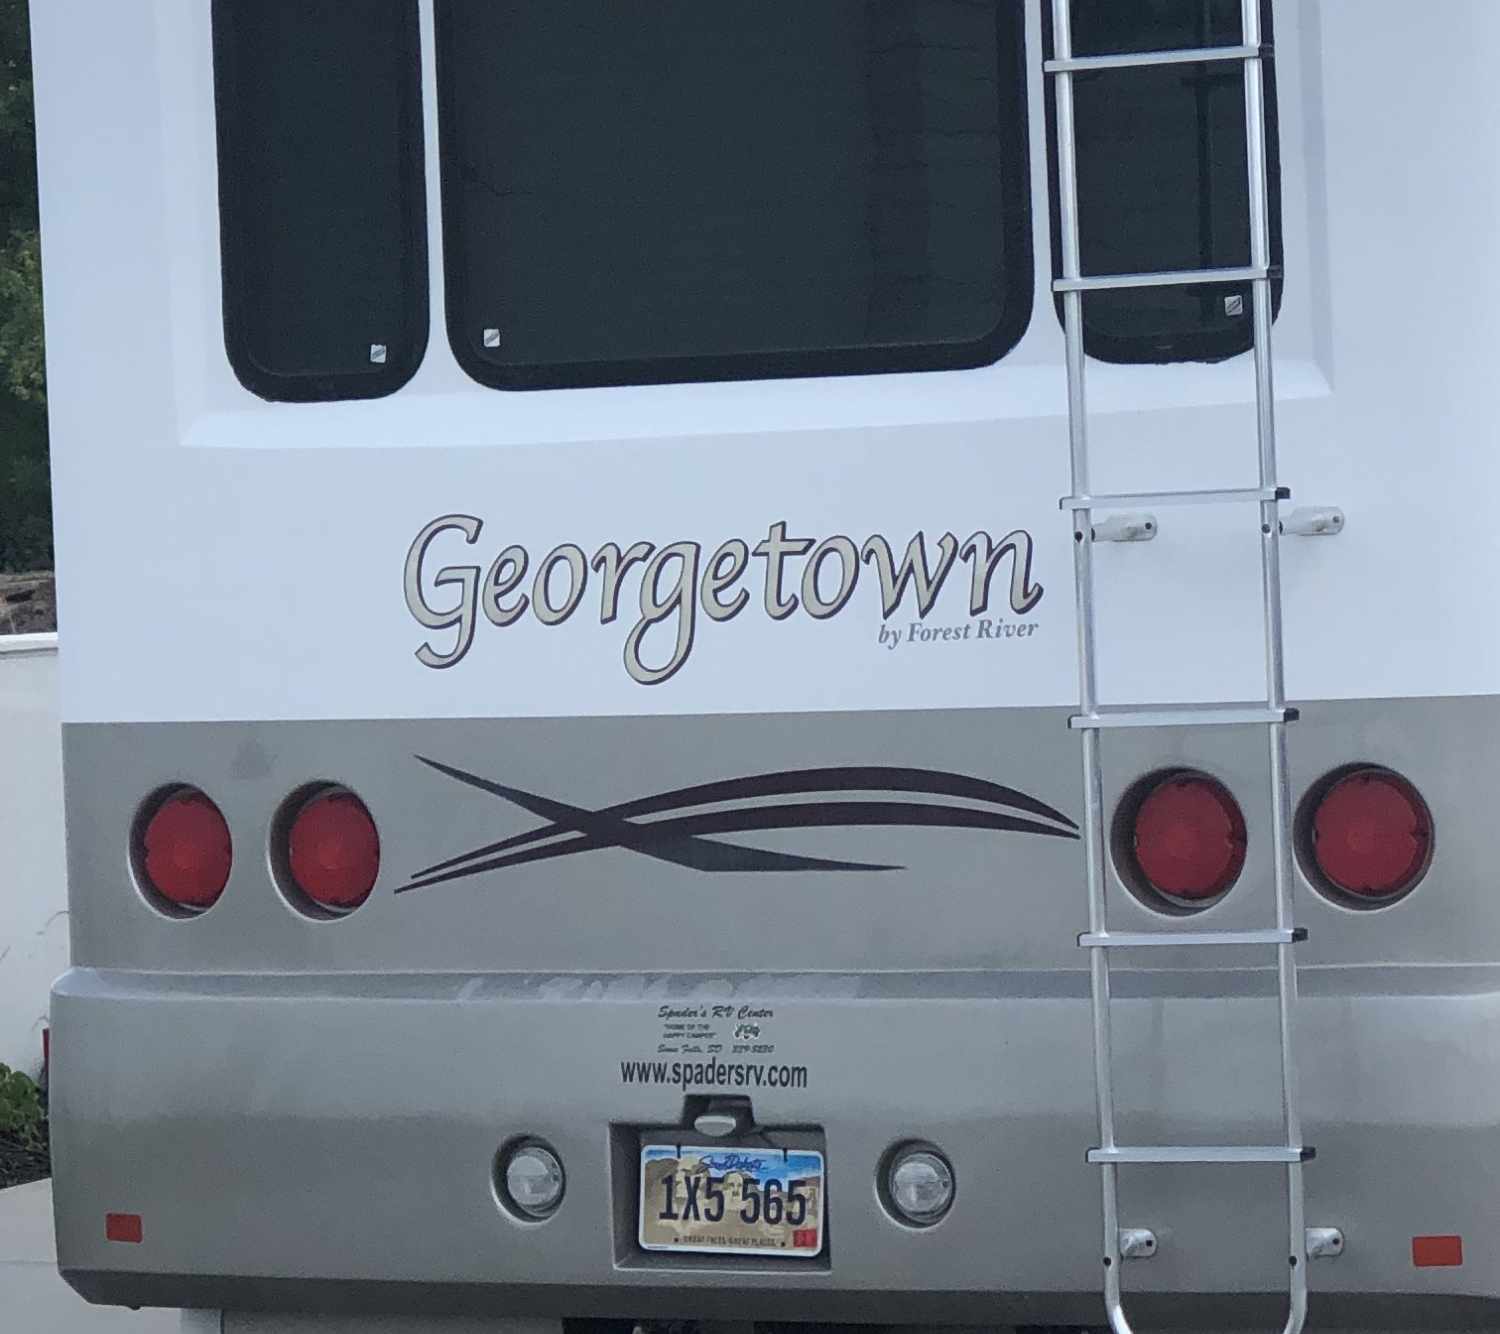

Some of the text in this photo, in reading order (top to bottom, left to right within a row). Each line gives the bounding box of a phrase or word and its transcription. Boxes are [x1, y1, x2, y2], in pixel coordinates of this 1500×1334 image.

[403, 513, 1044, 686] Georgetown
[878, 618, 1038, 650] by Forest River
[657, 1005, 773, 1020] Spader's RV Center
[620, 1057, 808, 1091] www.spadersrv.com
[659, 1175, 807, 1226] 1X5 565
